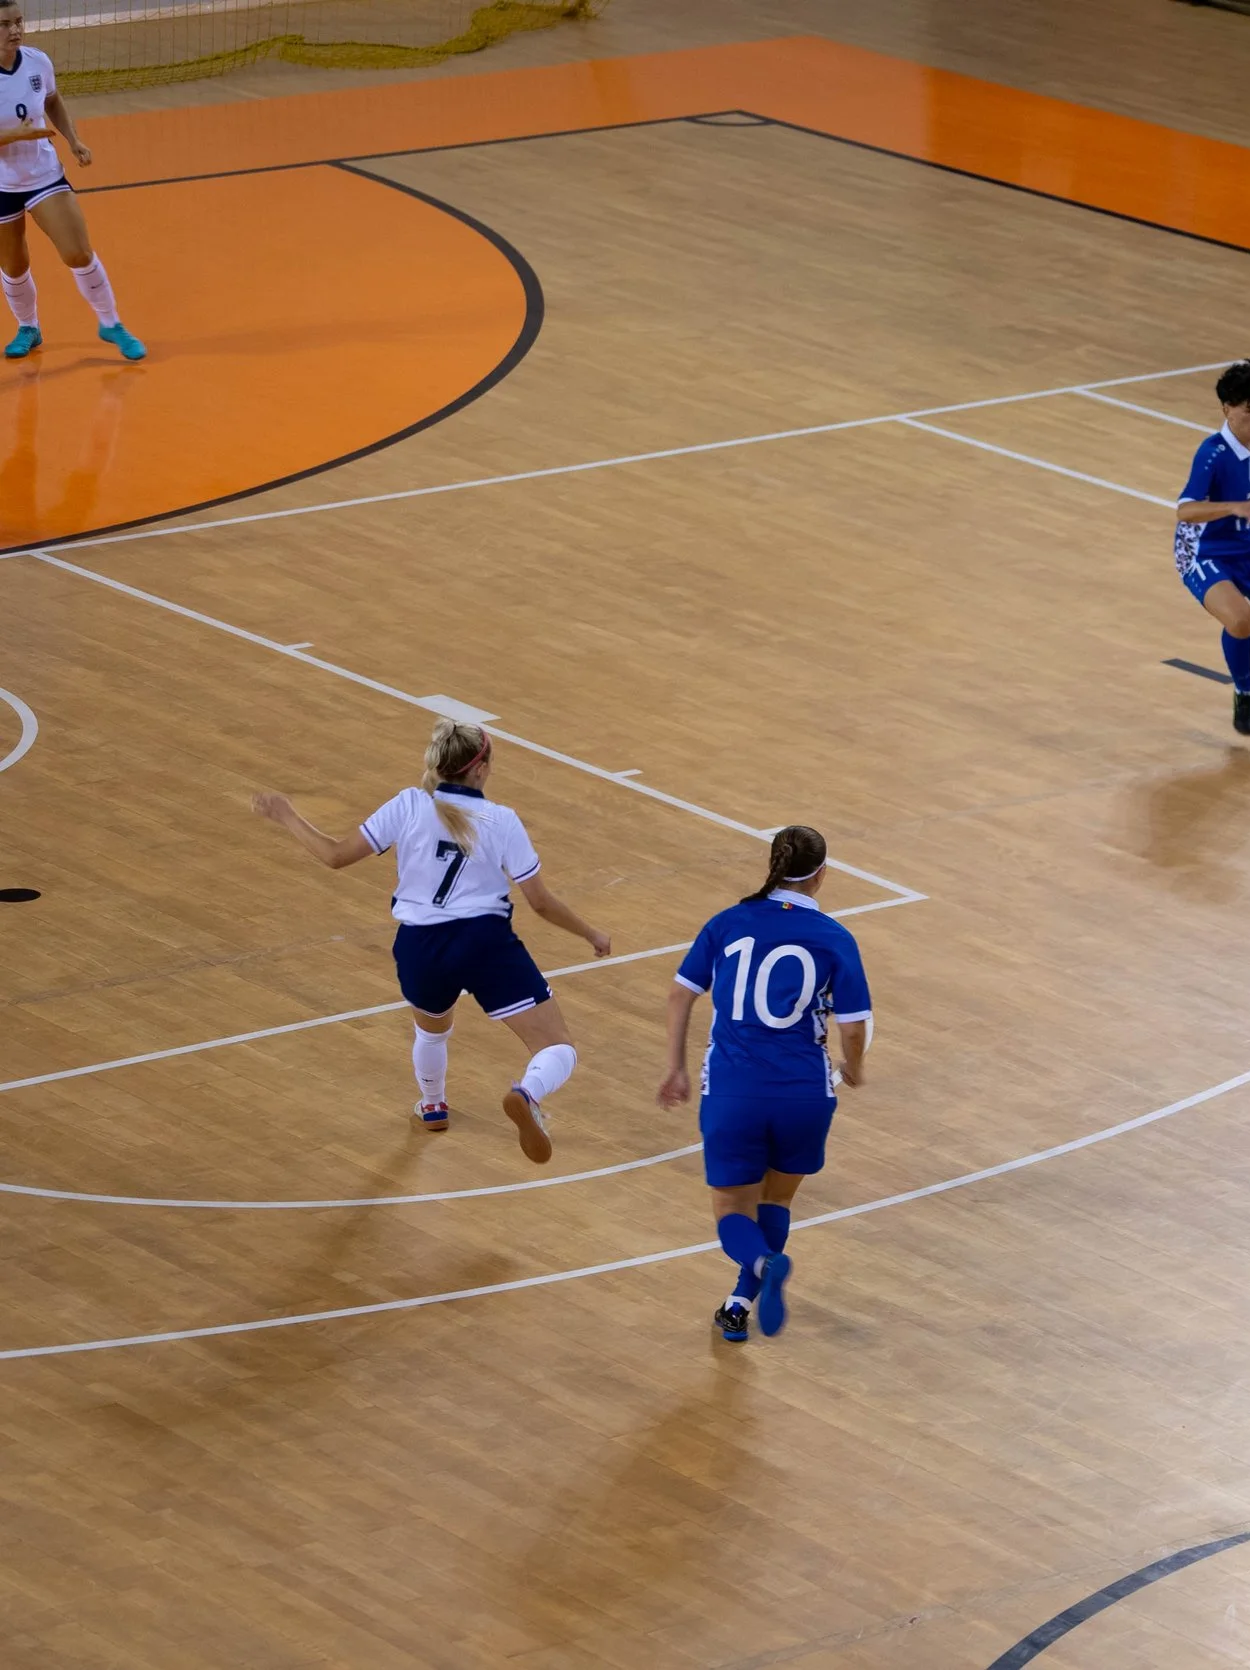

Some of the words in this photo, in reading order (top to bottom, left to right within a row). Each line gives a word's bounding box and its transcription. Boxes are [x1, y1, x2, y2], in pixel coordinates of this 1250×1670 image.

[15, 103, 28, 122] 9
[432, 839, 469, 909] 7
[724, 936, 816, 1029] 10
